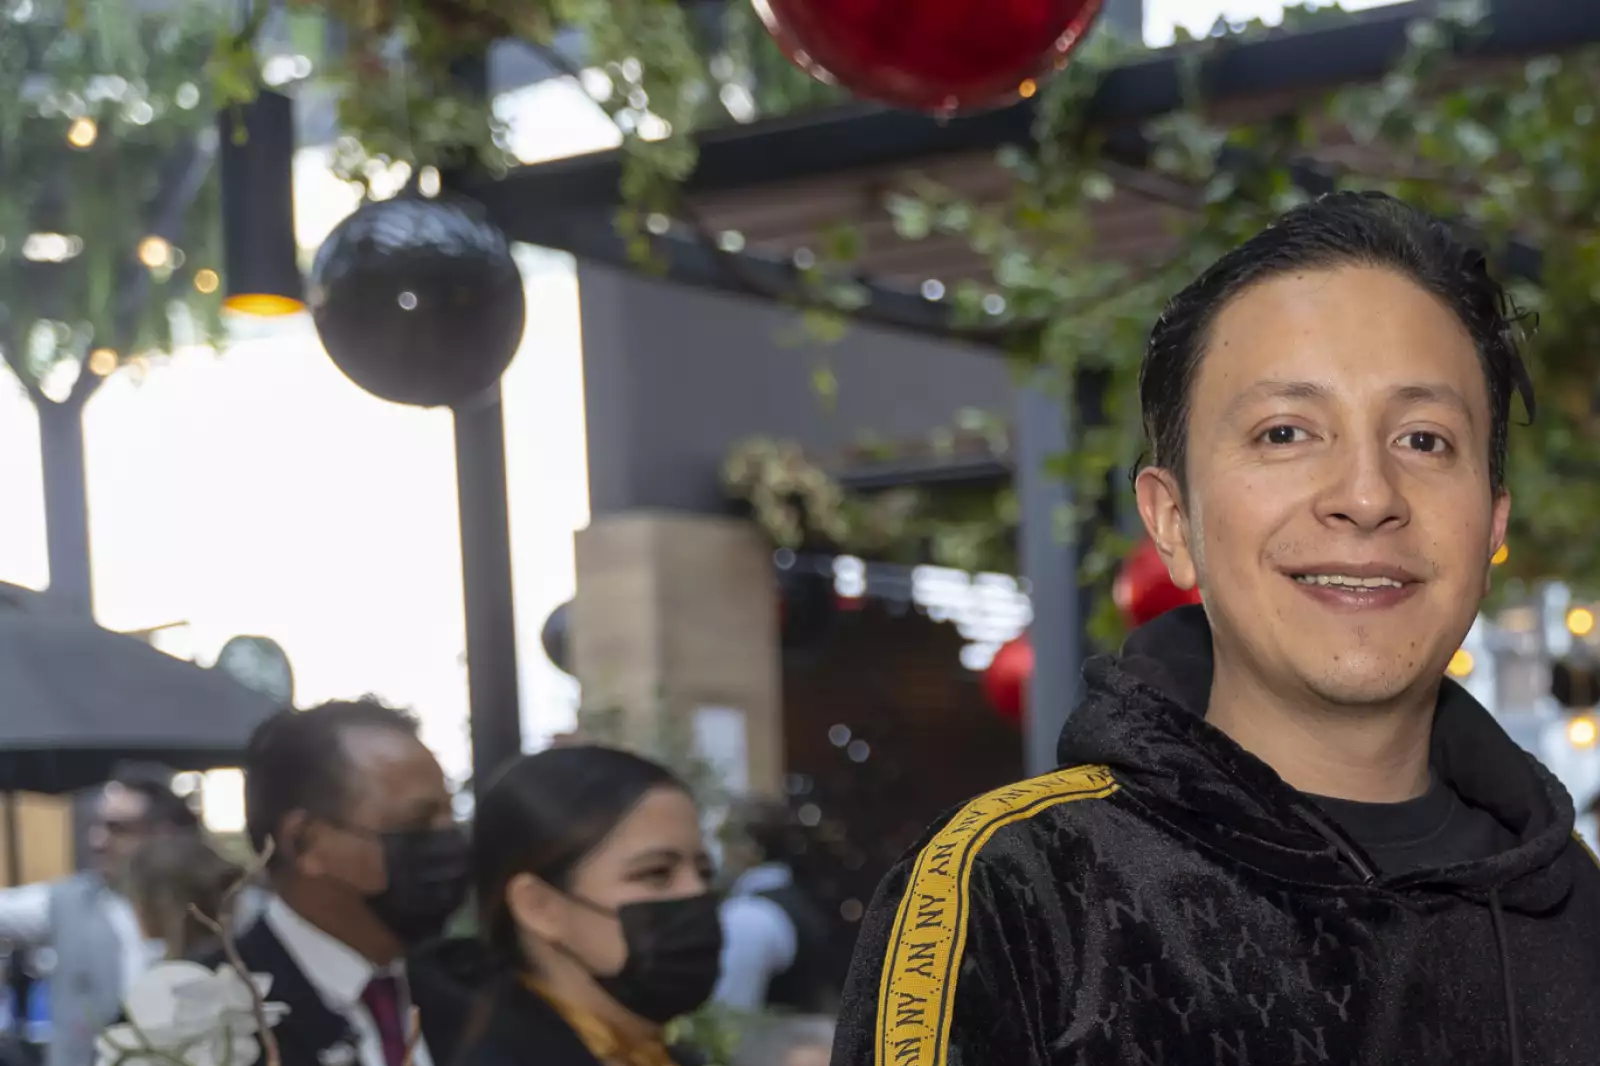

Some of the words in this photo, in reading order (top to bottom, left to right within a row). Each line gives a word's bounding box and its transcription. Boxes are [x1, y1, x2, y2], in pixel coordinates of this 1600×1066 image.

[947, 804, 988, 836] NY
[928, 842, 957, 876] NY
[915, 894, 946, 929] NY
[904, 941, 937, 977] NY
[896, 992, 927, 1028] NY
